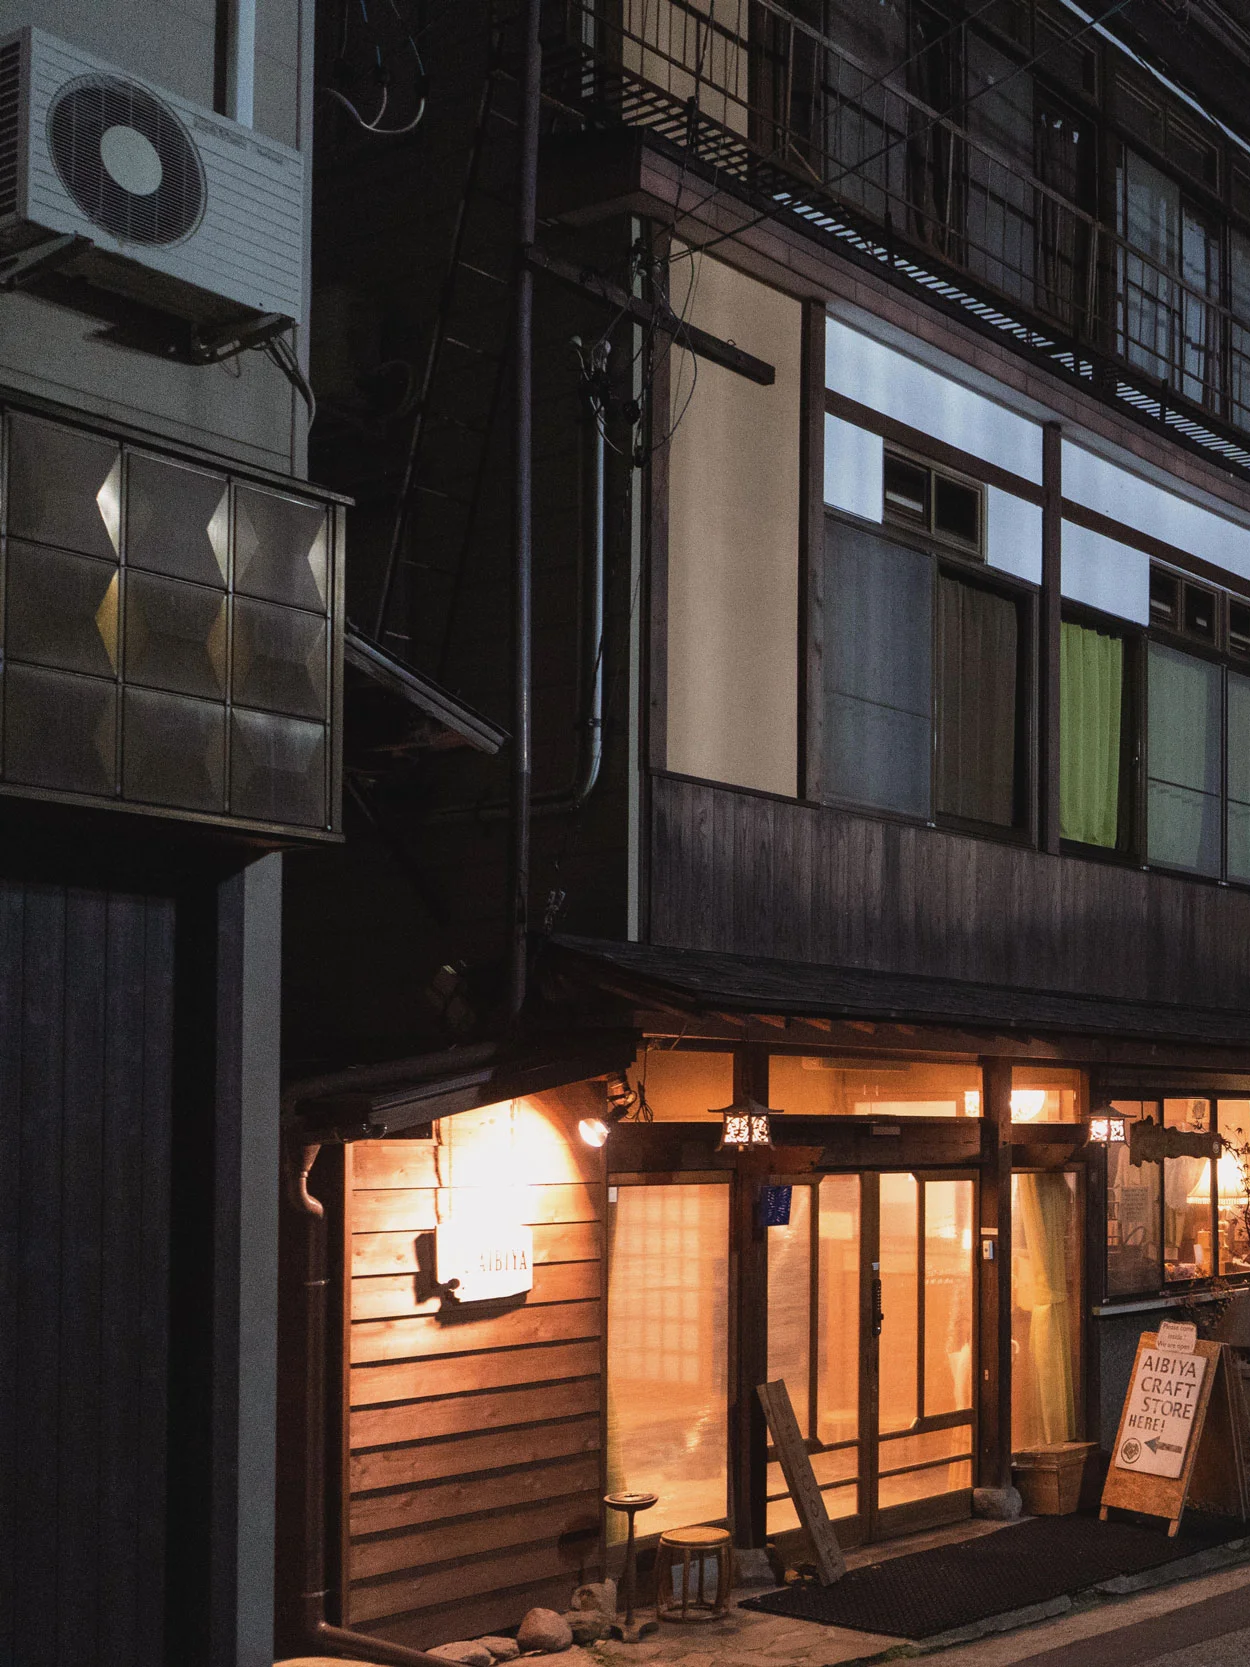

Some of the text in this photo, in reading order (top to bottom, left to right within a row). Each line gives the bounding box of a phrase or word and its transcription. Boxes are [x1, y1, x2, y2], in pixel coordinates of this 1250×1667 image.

[1142, 1355, 1196, 1378] AIBIYA
[1141, 1376, 1196, 1399] CRAFT
[1141, 1396, 1193, 1420] STORE
[1128, 1414, 1166, 1433] HERE!
